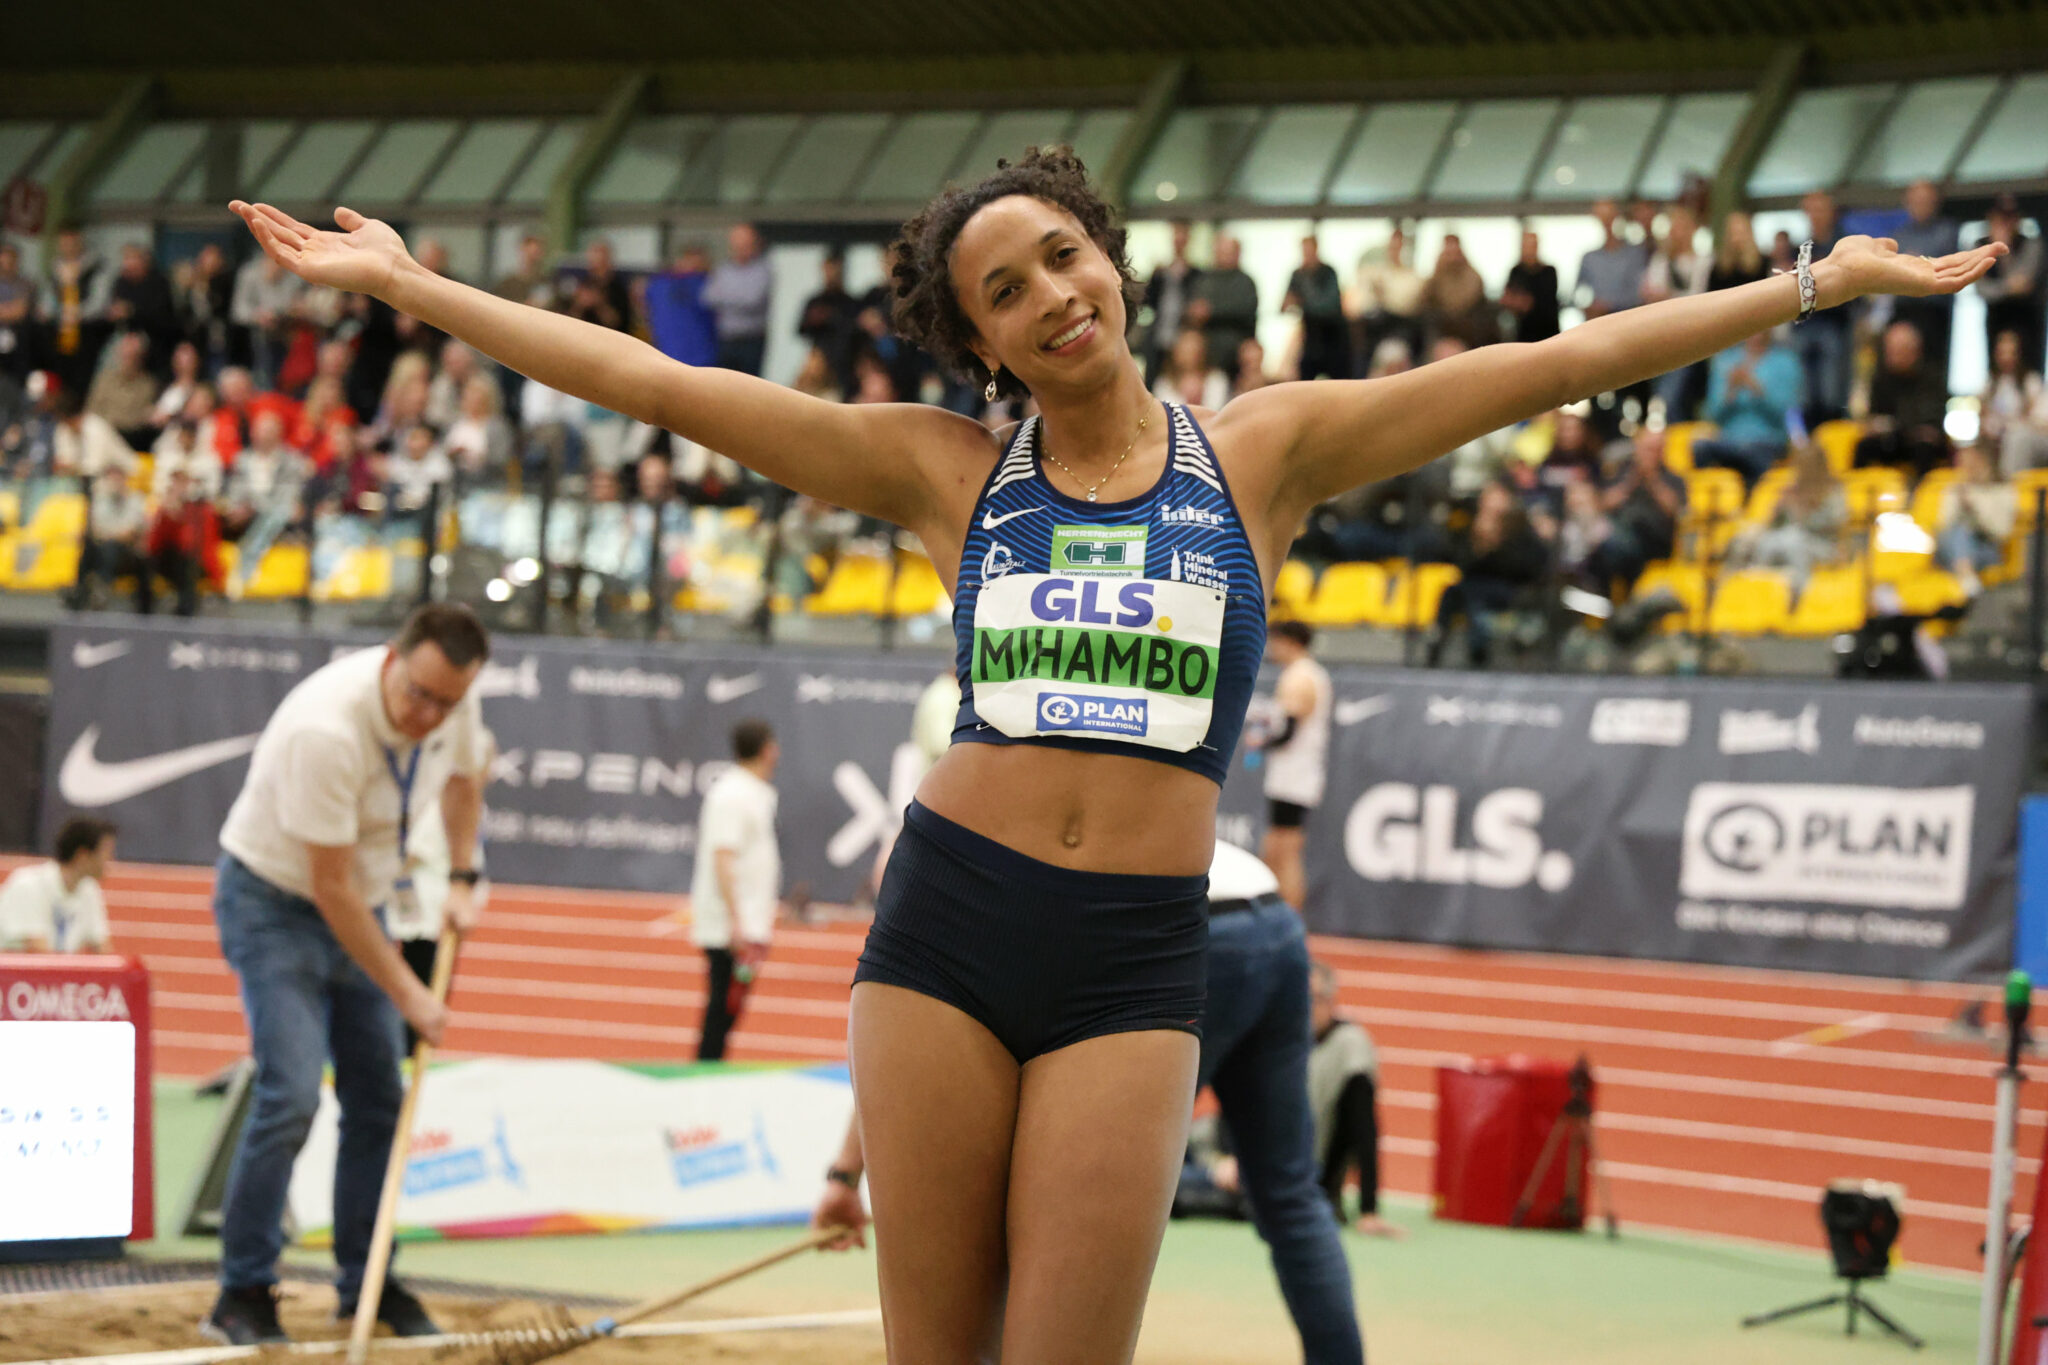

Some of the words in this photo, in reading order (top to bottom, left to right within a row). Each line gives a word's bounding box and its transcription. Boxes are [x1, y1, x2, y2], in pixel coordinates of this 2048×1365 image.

[1161, 504, 1225, 525] inter
[1057, 529, 1145, 539] HERRENKNECHT
[1184, 551, 1215, 565] Trink
[1184, 561, 1228, 580] Mineral
[1184, 572, 1230, 593] Wasser
[980, 628, 1210, 696] MIHAMBO
[1083, 702, 1144, 723] PLAN
[1083, 719, 1143, 732] INTERNATIONAL
[1801, 812, 1952, 858] PLAN
[8, 981, 131, 1020] OMEGA
